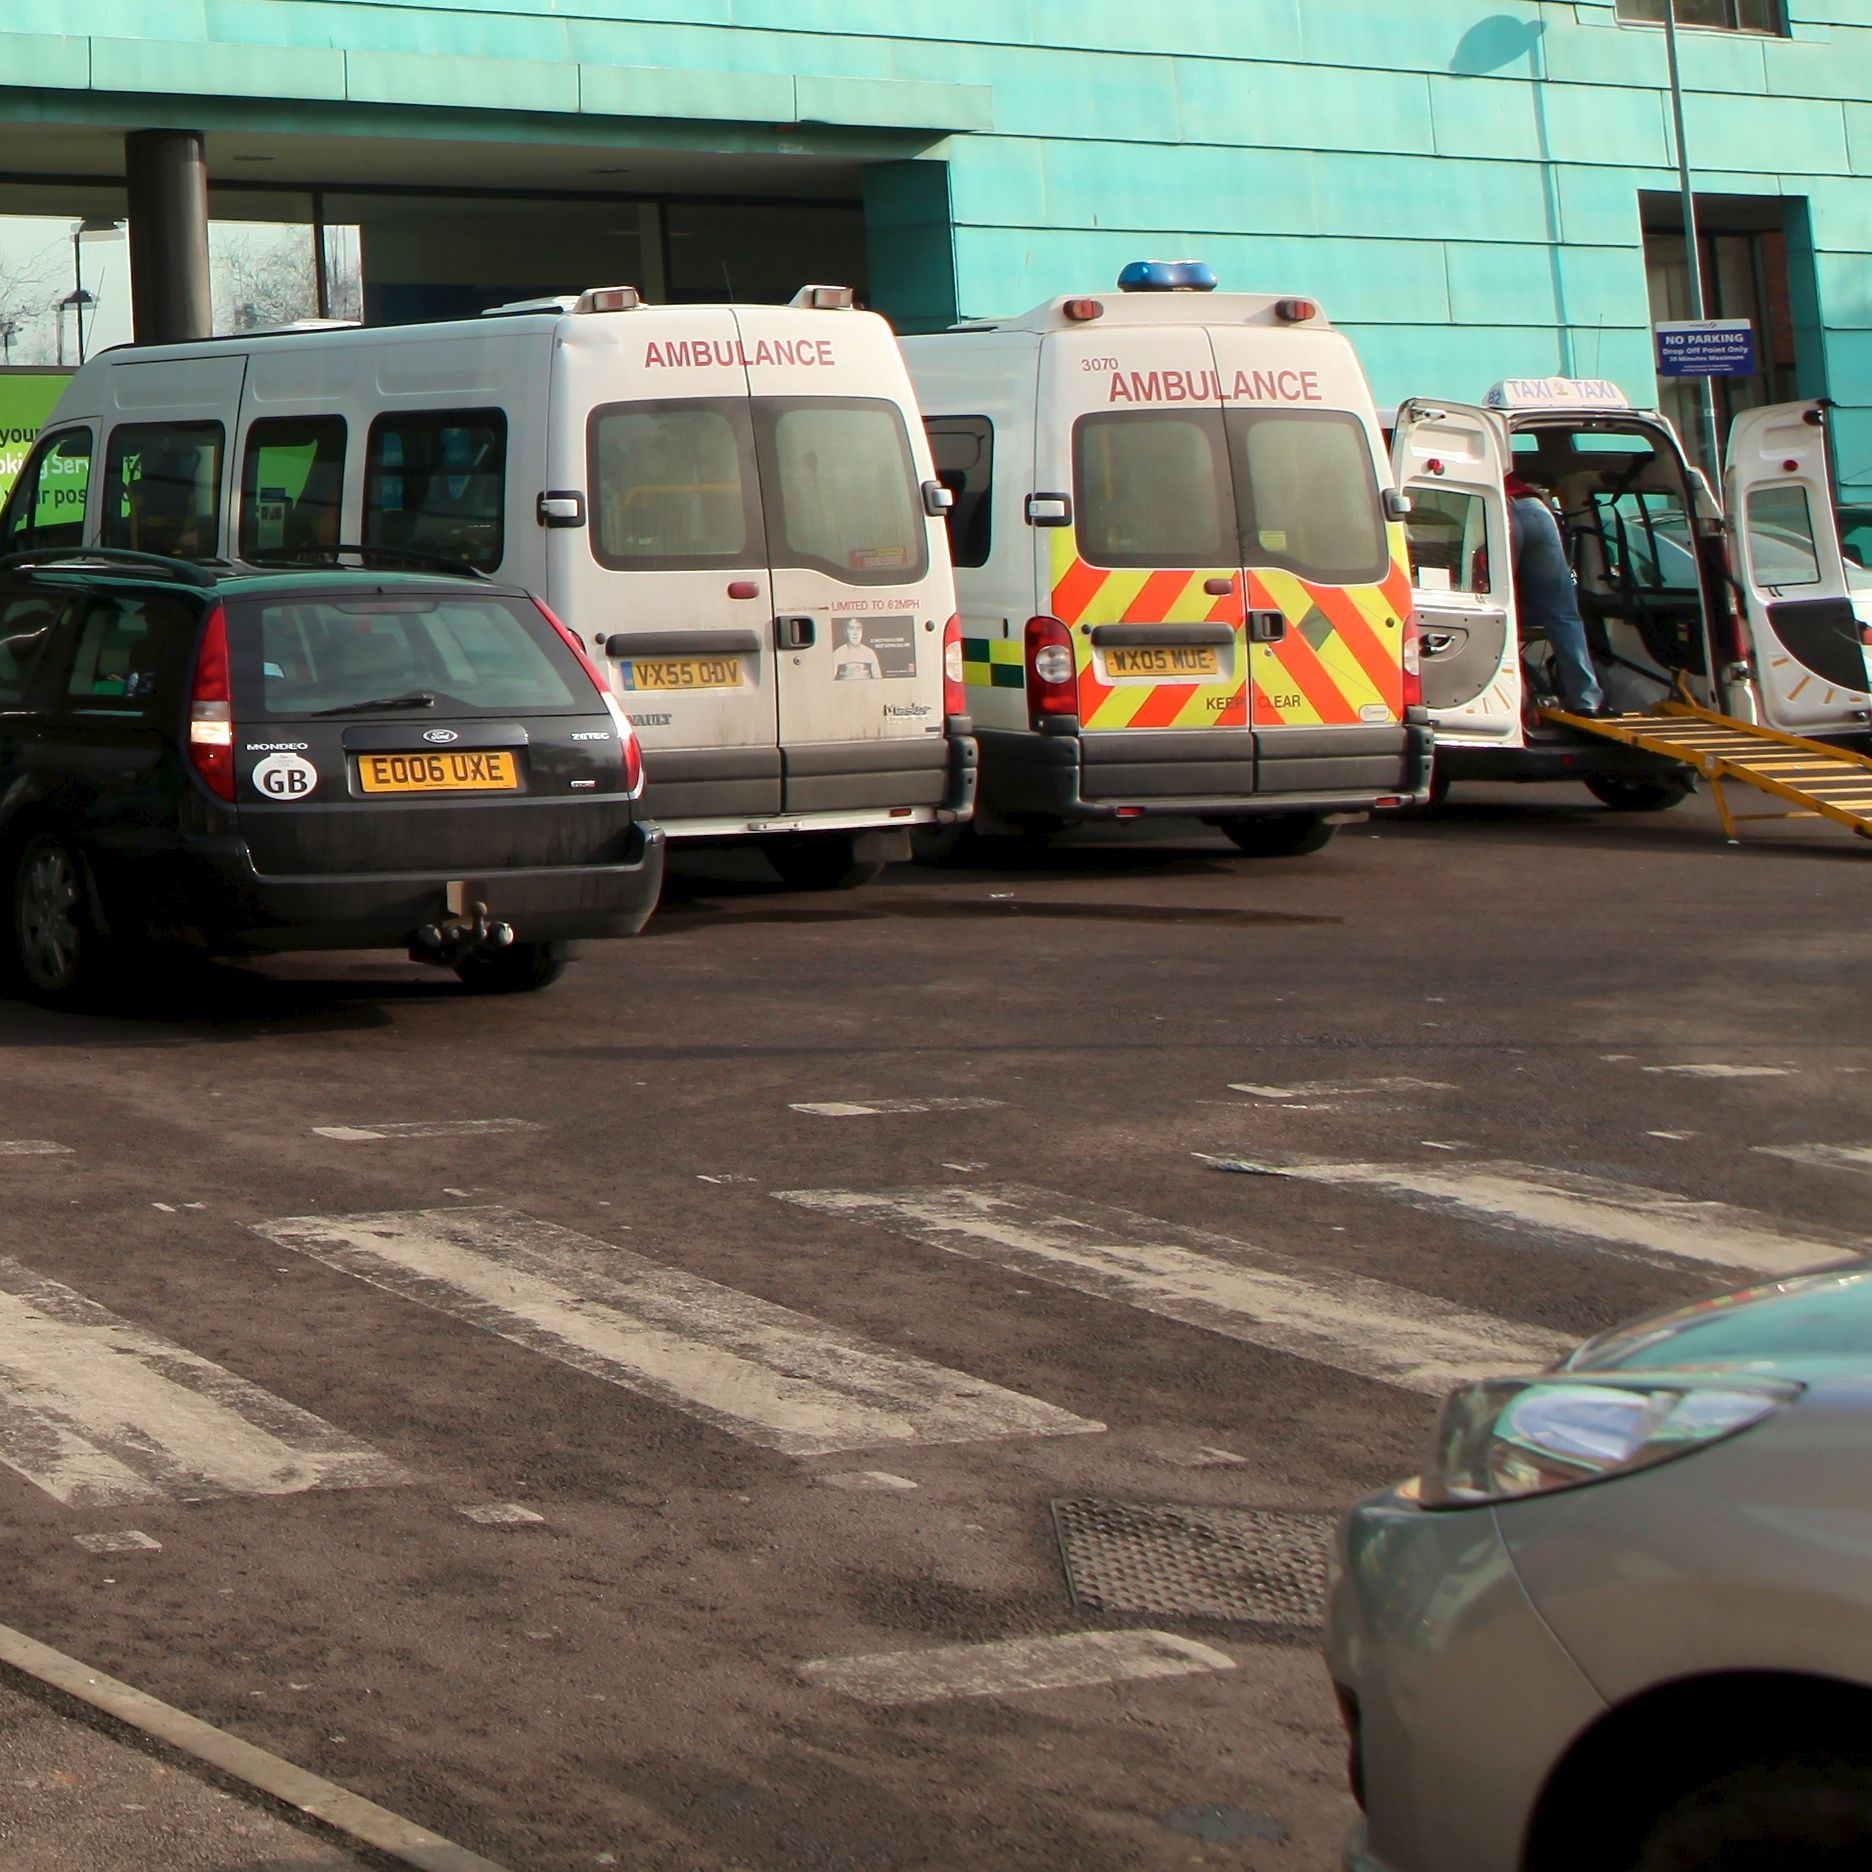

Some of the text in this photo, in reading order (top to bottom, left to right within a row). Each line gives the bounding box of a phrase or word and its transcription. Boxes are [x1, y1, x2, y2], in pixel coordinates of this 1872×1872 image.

[1665, 333, 1744, 345] NO PARKING
[644, 339, 836, 368] AMBULANCE
[1080, 357, 1118, 372] 3070
[1108, 370, 1322, 403] AMBULANCE
[1506, 380, 1617, 399] TAXI TAXI
[0, 427, 39, 449] you
[831, 600, 869, 612] LIMITED
[872, 600, 885, 611] TO
[887, 599, 921, 610] 62MPH
[1112, 649, 1168, 671] WX05
[636, 660, 738, 686] VX55 ODV
[1206, 694, 1301, 710] KEEP CLEAR
[246, 742, 308, 751] MONDEO
[451, 754, 505, 782] UXE
[263, 769, 308, 794] GB
